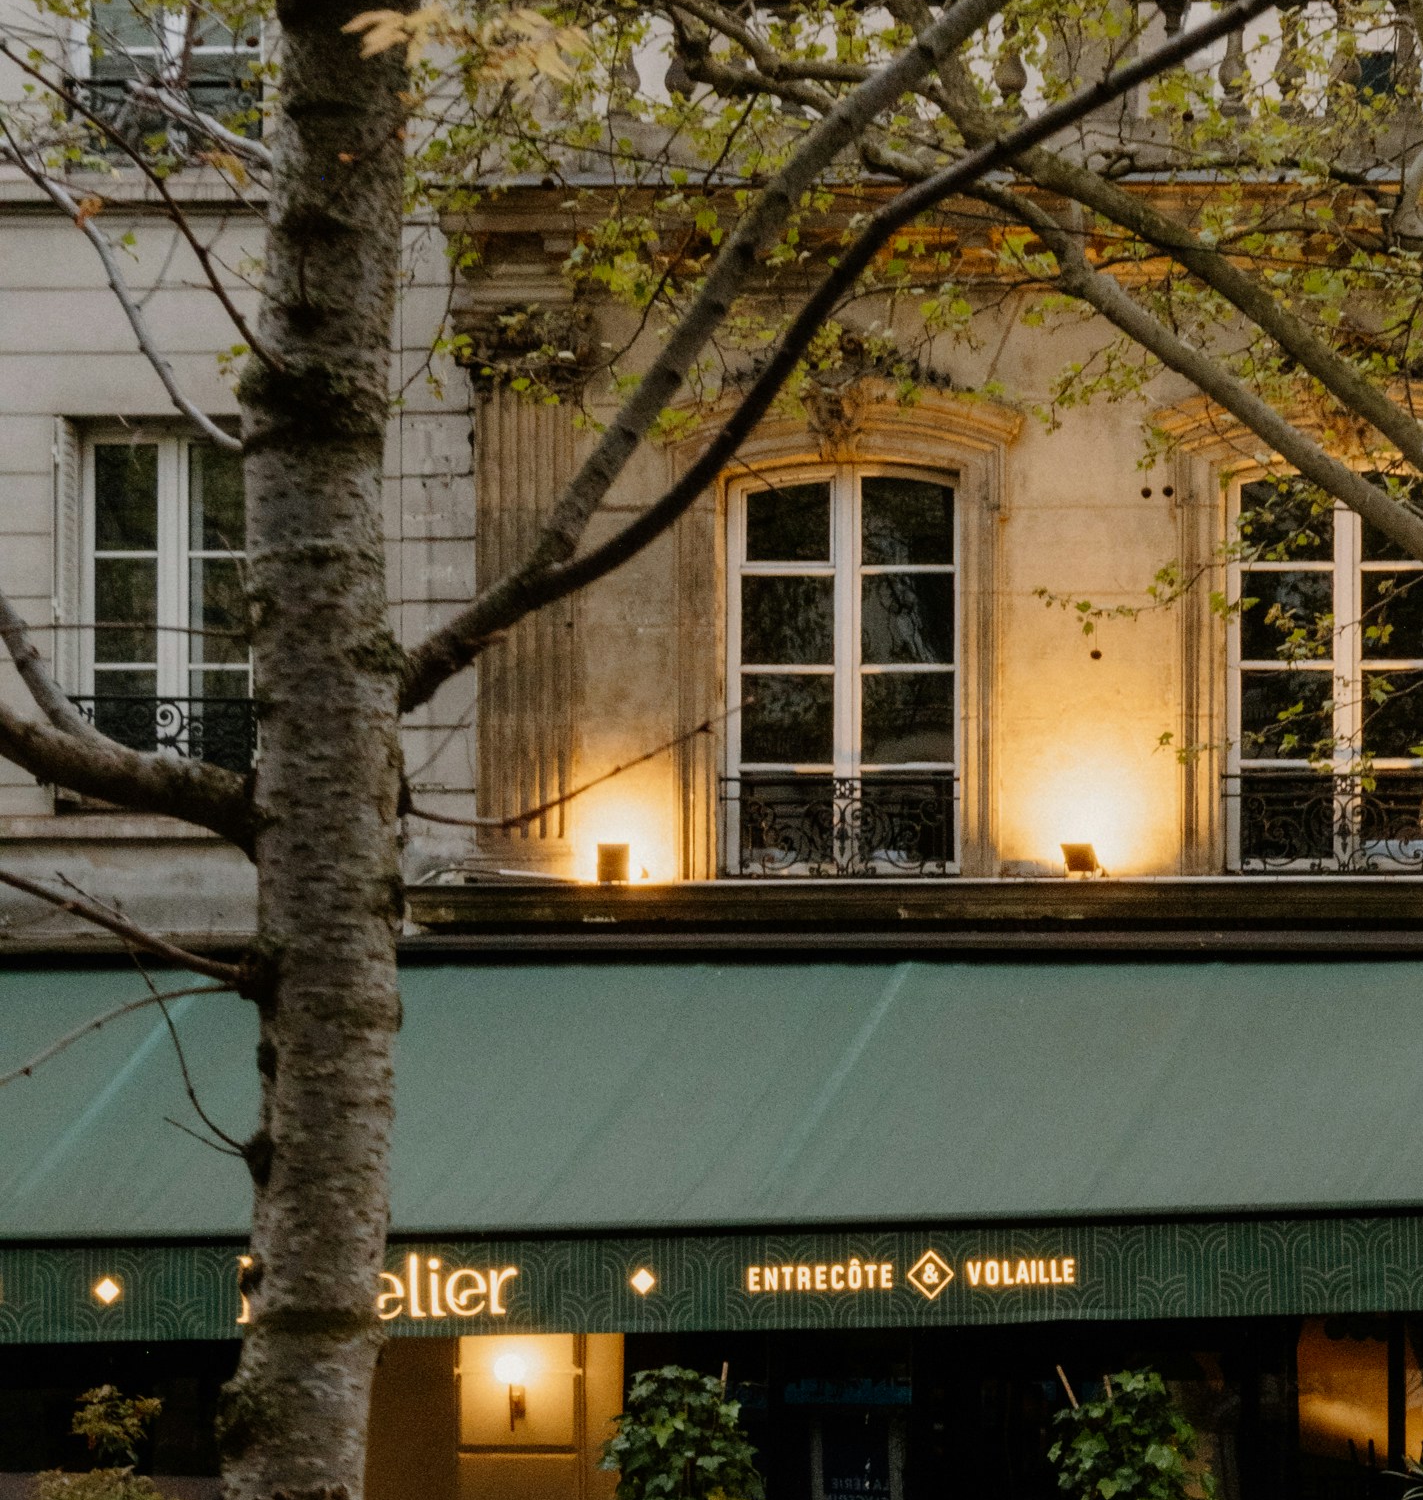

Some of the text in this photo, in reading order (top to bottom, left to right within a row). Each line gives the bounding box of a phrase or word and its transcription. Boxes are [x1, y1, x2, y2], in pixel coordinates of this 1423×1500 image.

[747, 1257, 1076, 1291] ENTRECÔTE & VOLAILLE
